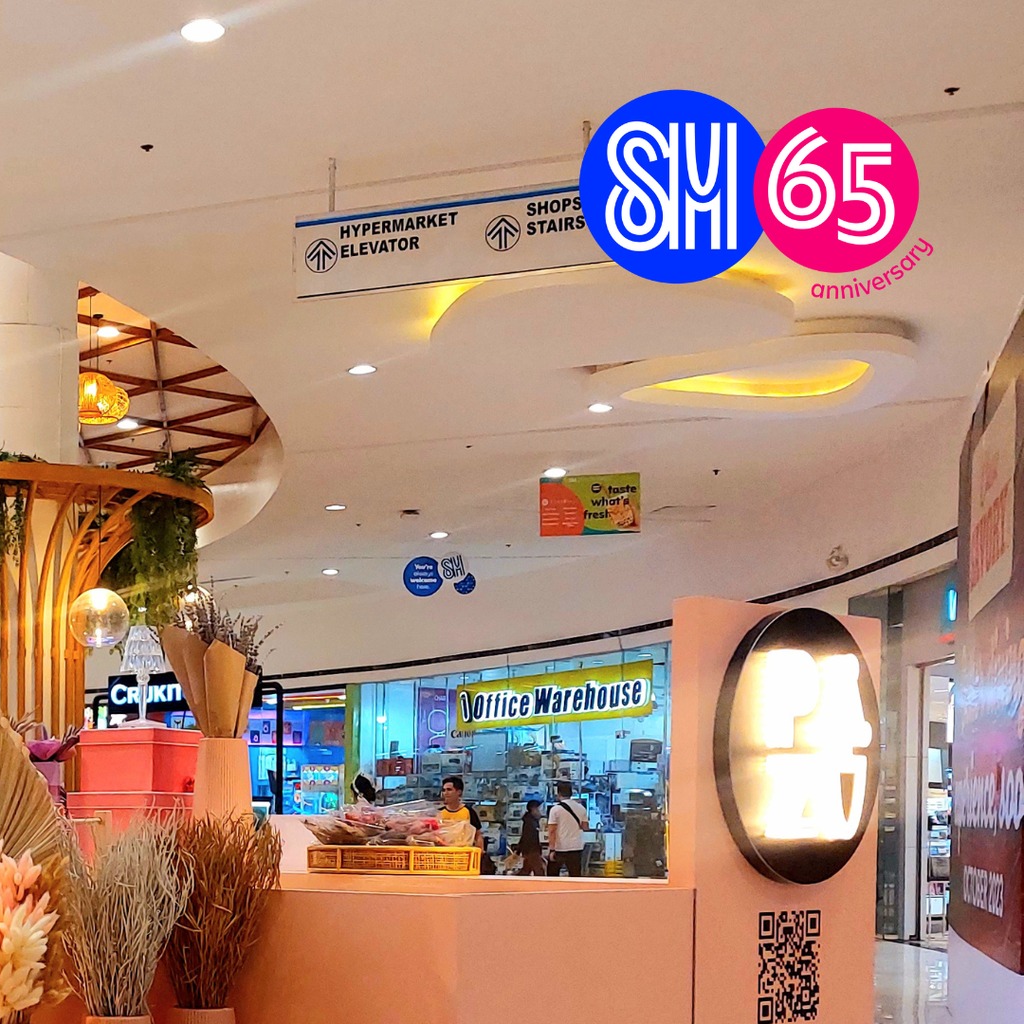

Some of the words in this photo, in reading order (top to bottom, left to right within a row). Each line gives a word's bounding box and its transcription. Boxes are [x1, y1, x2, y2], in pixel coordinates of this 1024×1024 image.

[526, 196, 582, 216] SHOPS
[340, 211, 458, 239] HYPERMARKET
[527, 215, 586, 236] STAIRS
[340, 236, 420, 259] ELEVATOR
[608, 484, 637, 494] taste
[591, 496, 630, 507] what's
[584, 509, 611, 519] fresh
[473, 691, 532, 720] Office
[533, 680, 643, 715] Warehouse
